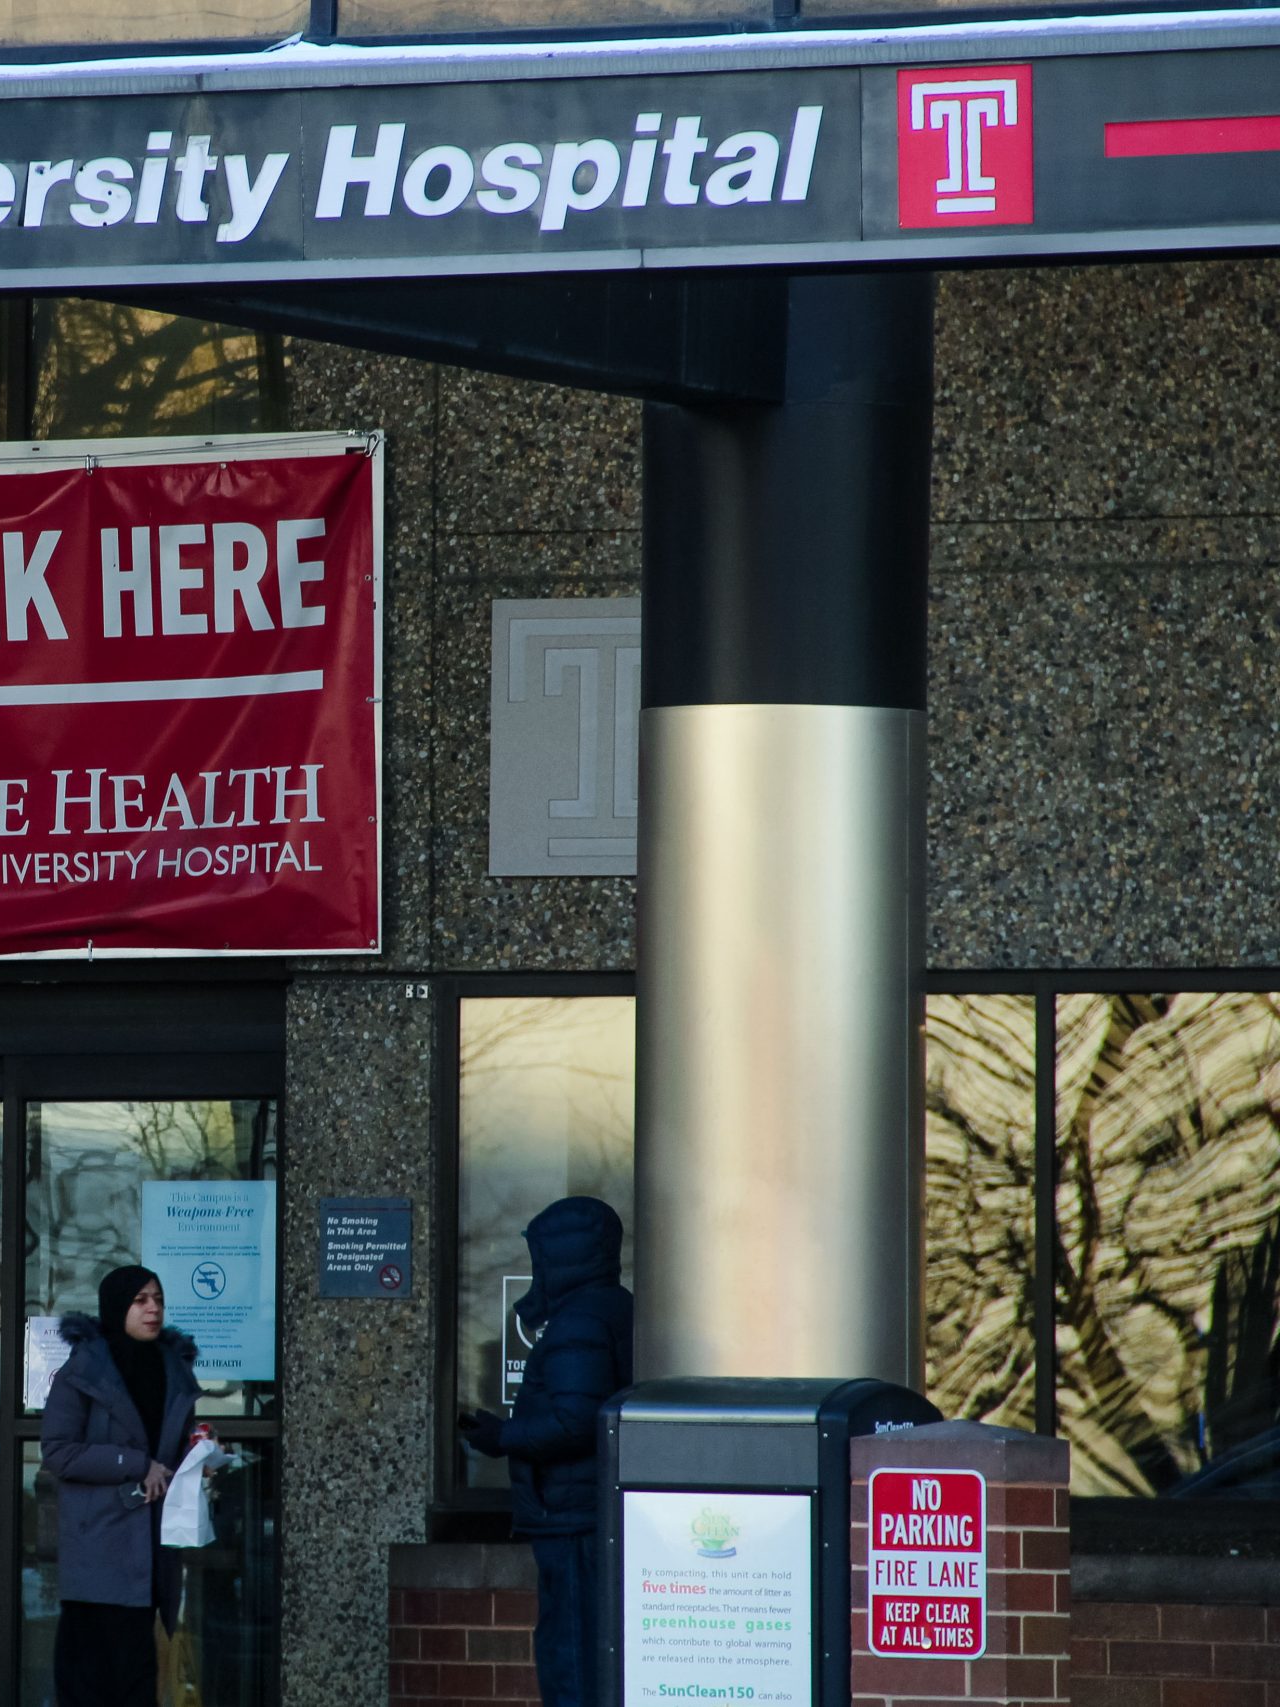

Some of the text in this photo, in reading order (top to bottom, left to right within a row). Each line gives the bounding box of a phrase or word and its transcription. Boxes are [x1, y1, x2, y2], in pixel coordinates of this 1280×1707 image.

[315, 105, 823, 231] Hospital
[101, 518, 326, 638] HERE
[49, 764, 325, 836] HEALTH
[158, 841, 322, 878] HOSPITAL
[170, 1192, 191, 1202] This
[193, 1192, 232, 1204] Campus
[234, 1192, 241, 1202] is
[177, 1222, 240, 1232] Environment
[327, 1217, 378, 1227] No Smoking
[337, 1227, 354, 1235] This
[357, 1227, 377, 1235] Area
[328, 1242, 407, 1251] Smoking Permitted
[337, 1253, 384, 1262] Designated
[327, 1263, 374, 1272] Areas Only
[912, 1479, 941, 1511] NO
[880, 1513, 974, 1547] PARKING
[641, 1568, 652, 1577] By
[712, 1569, 728, 1578] this
[731, 1570, 748, 1579] unit
[752, 1572, 768, 1580] can
[771, 1570, 792, 1580] hold
[875, 1560, 978, 1588] FIRE LANE
[642, 1580, 667, 1594] five
[670, 1581, 706, 1595] times
[709, 1587, 722, 1595] the
[723, 1588, 753, 1596] amount
[754, 1587, 763, 1596] of
[764, 1588, 781, 1597] litter
[641, 1603, 675, 1611] standard
[722, 1604, 740, 1613] That
[741, 1606, 768, 1614] means
[769, 1605, 792, 1614] fewer
[885, 1602, 970, 1624] KEEP CLEAR
[642, 1616, 793, 1633] greenhouse gases
[641, 1637, 792, 1650] which contribute to global warming
[880, 1626, 974, 1648] AT ALL TIMES
[641, 1654, 793, 1667] are released into the atmosphere.
[642, 1684, 793, 1701] The SunClean150 can also
